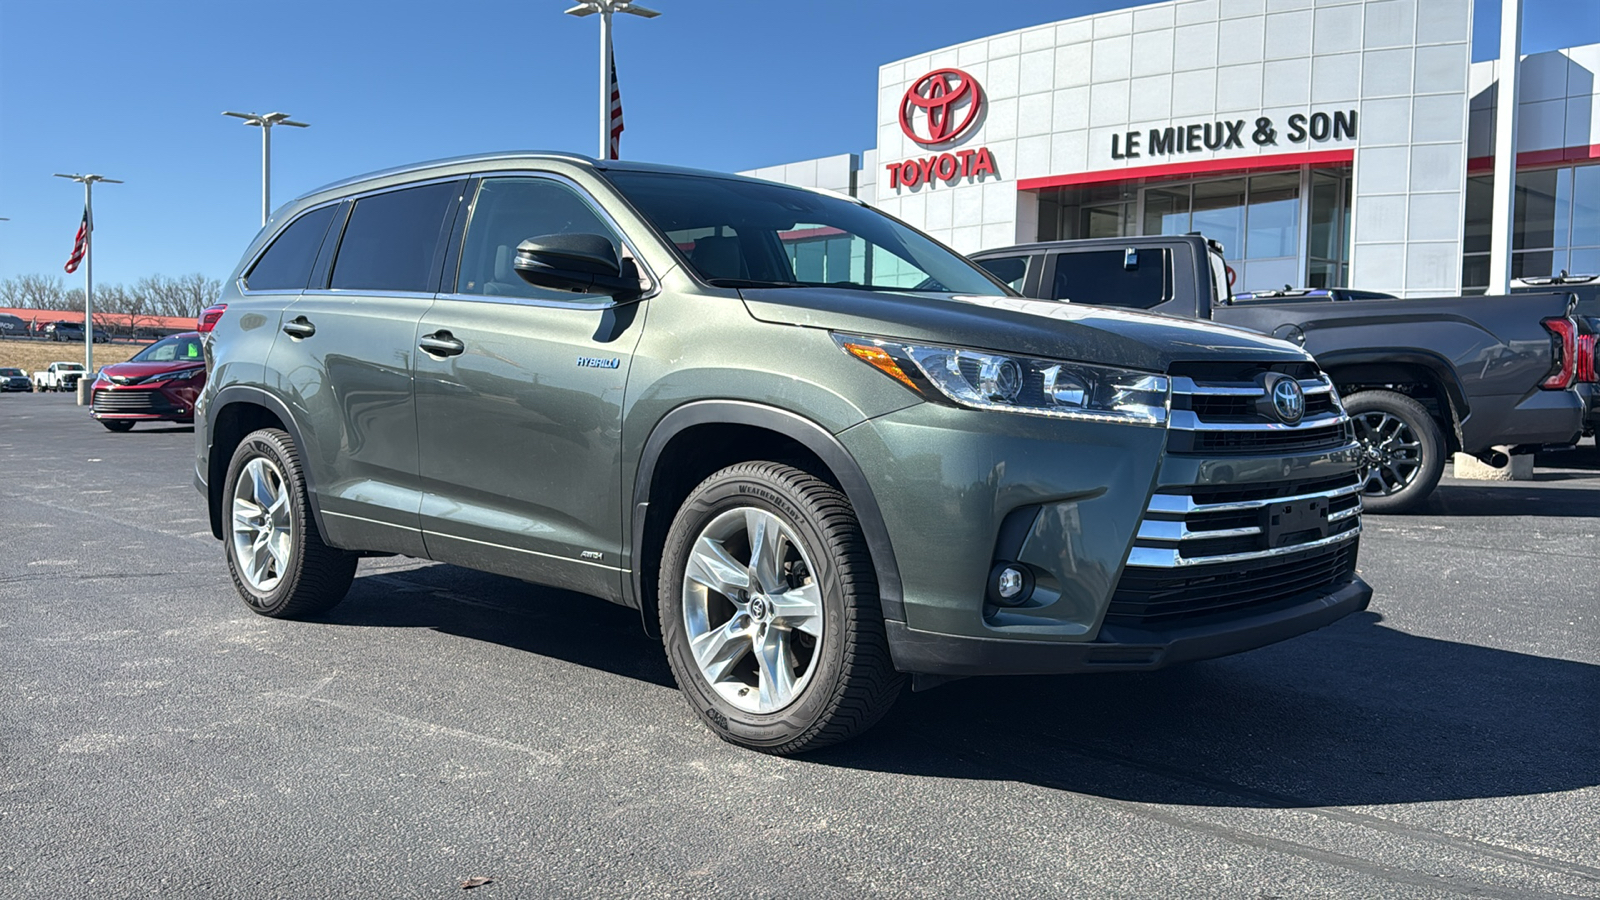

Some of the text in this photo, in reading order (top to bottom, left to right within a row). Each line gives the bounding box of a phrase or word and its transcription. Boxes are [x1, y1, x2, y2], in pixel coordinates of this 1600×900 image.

[1111, 111, 1357, 159] LE MIEUX & SON
[886, 147, 996, 189] TOYOTA
[576, 356, 614, 369] HYBRID
